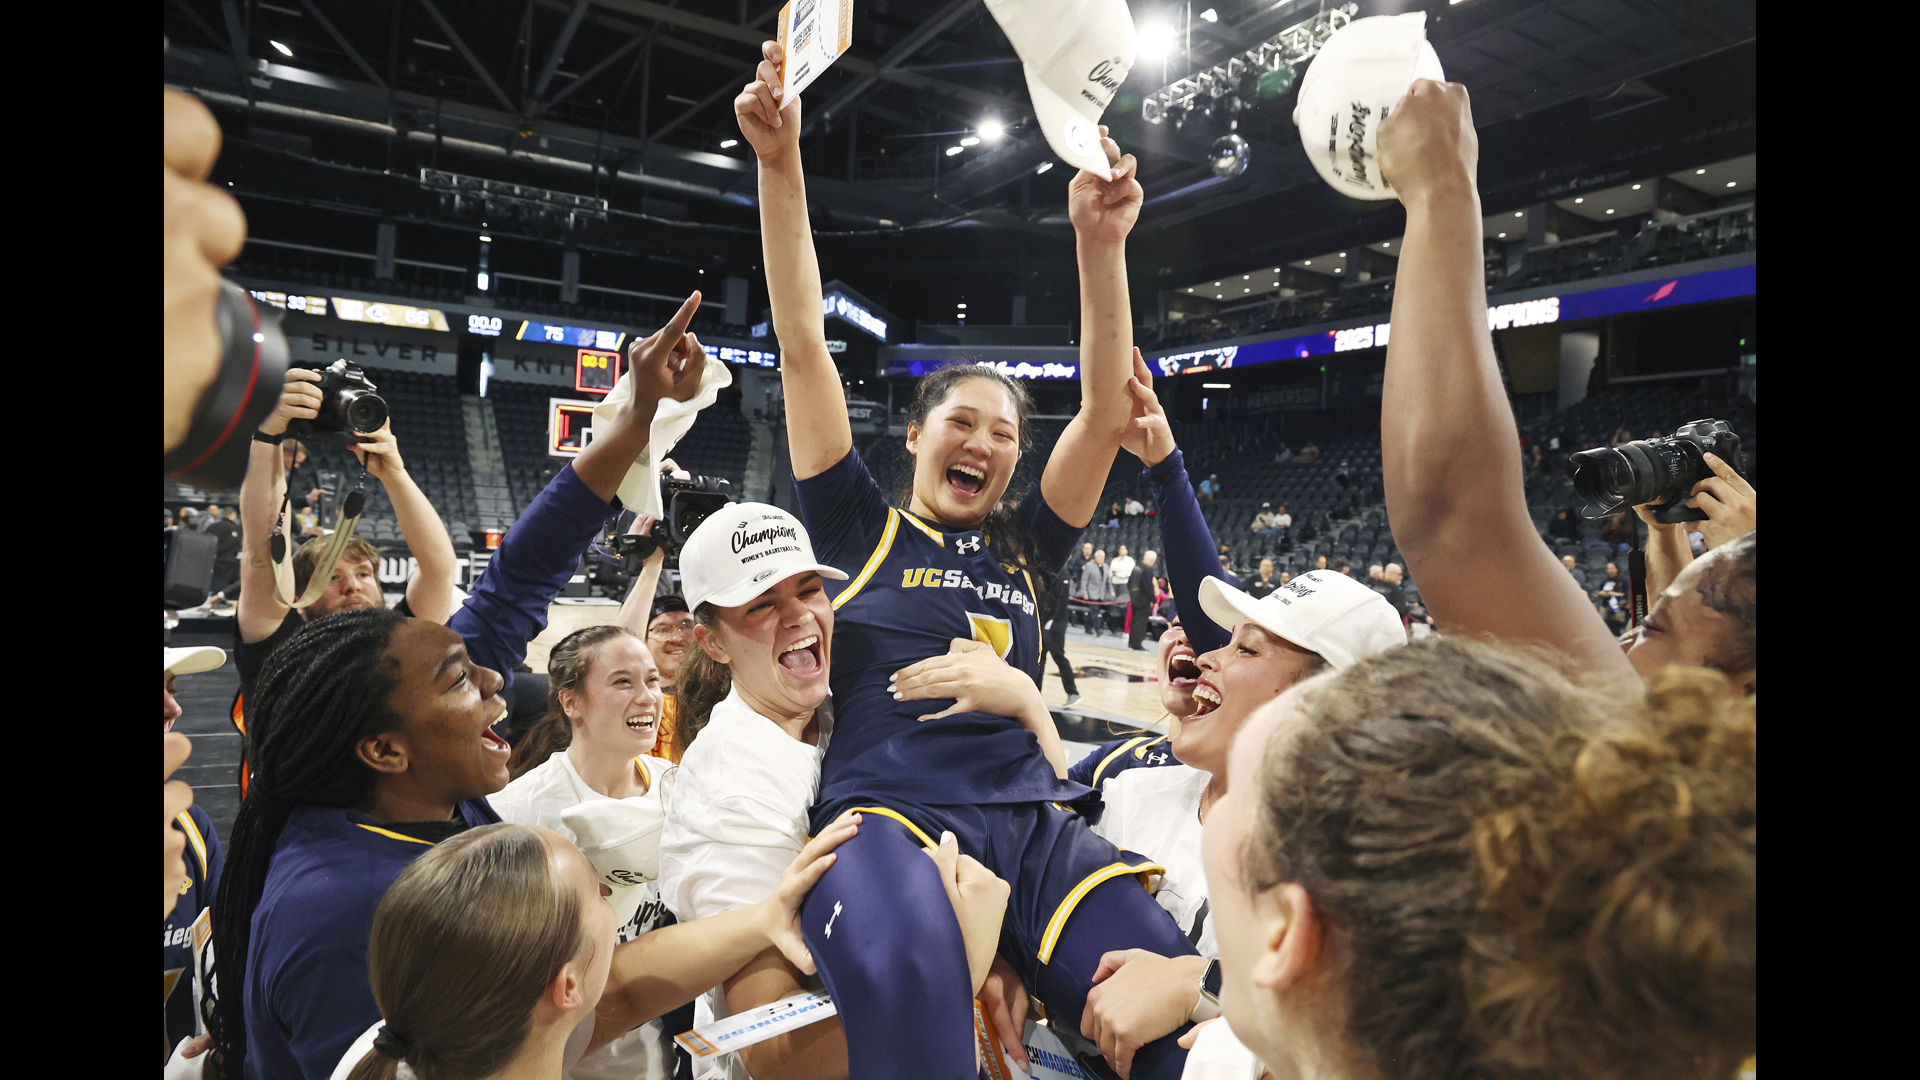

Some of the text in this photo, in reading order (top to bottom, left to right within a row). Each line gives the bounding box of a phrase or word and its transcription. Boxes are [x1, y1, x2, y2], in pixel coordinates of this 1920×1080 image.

[404, 309, 430, 326] 66
[543, 325, 564, 342] 75
[1335, 323, 1391, 352] 2025 BI
[312, 333, 437, 363] SILVER
[848, 408, 872, 418] EST
[731, 525, 797, 554] Champions
[740, 551, 764, 565] WOMEN'S
[764, 545, 794, 557] BASKETBALL
[164, 923, 192, 949] ieg
[1025, 1044, 1086, 1080] CHMADNESS
